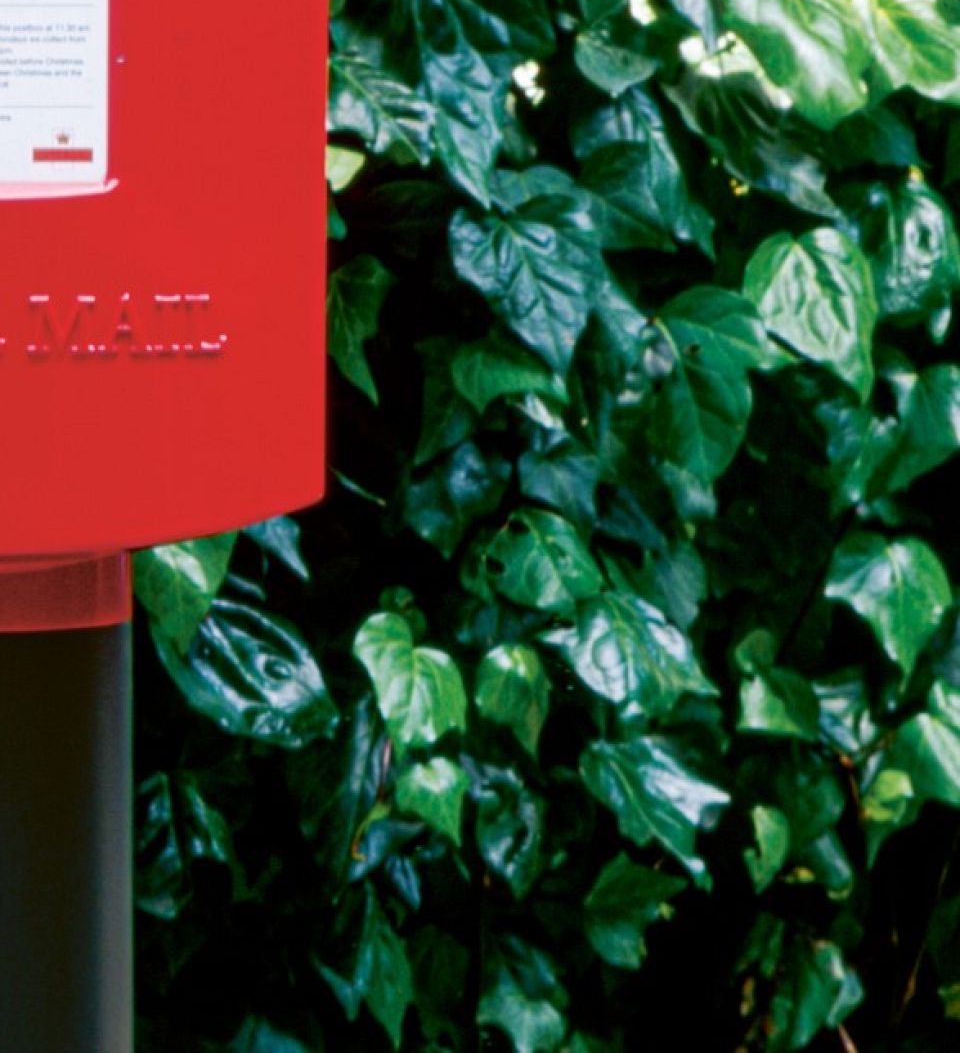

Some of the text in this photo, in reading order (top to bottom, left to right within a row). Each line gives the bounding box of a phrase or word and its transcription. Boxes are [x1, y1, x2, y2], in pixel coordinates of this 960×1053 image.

[12, 24, 44, 34] postbox
[42, 35, 66, 43] collect
[68, 35, 86, 43] from
[18, 58, 43, 66] before
[26, 291, 229, 358] MAIL
